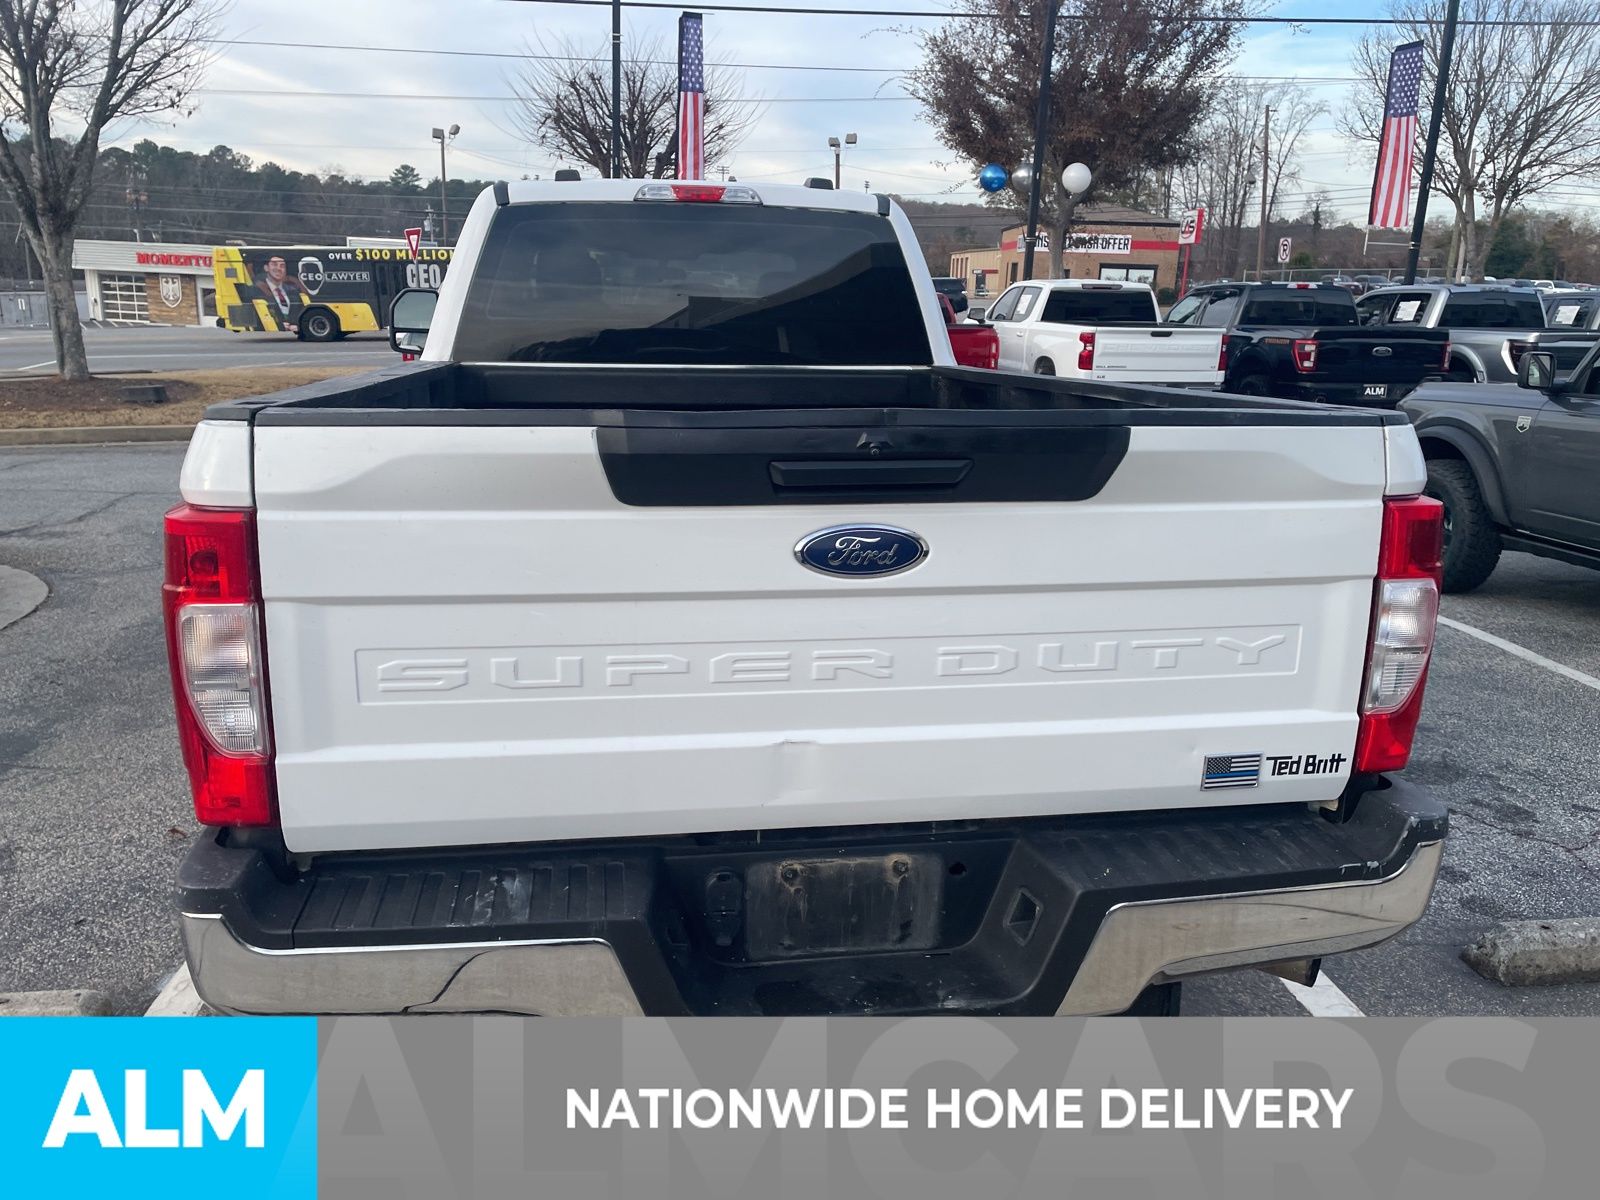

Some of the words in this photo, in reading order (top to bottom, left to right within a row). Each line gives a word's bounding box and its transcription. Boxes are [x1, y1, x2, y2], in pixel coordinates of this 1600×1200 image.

[1101, 236, 1129, 250] OFFER
[328, 252, 352, 260] OVER
[355, 248, 390, 262] $100
[300, 272, 324, 281] CEO
[324, 272, 369, 281] LAWYER
[1364, 386, 1385, 396] ALM
[827, 536, 899, 566] Ford
[377, 648, 894, 692] SUPER
[936, 633, 1287, 677] DUTY
[1266, 755, 1302, 776] Ted
[1303, 753, 1346, 775] Britt
